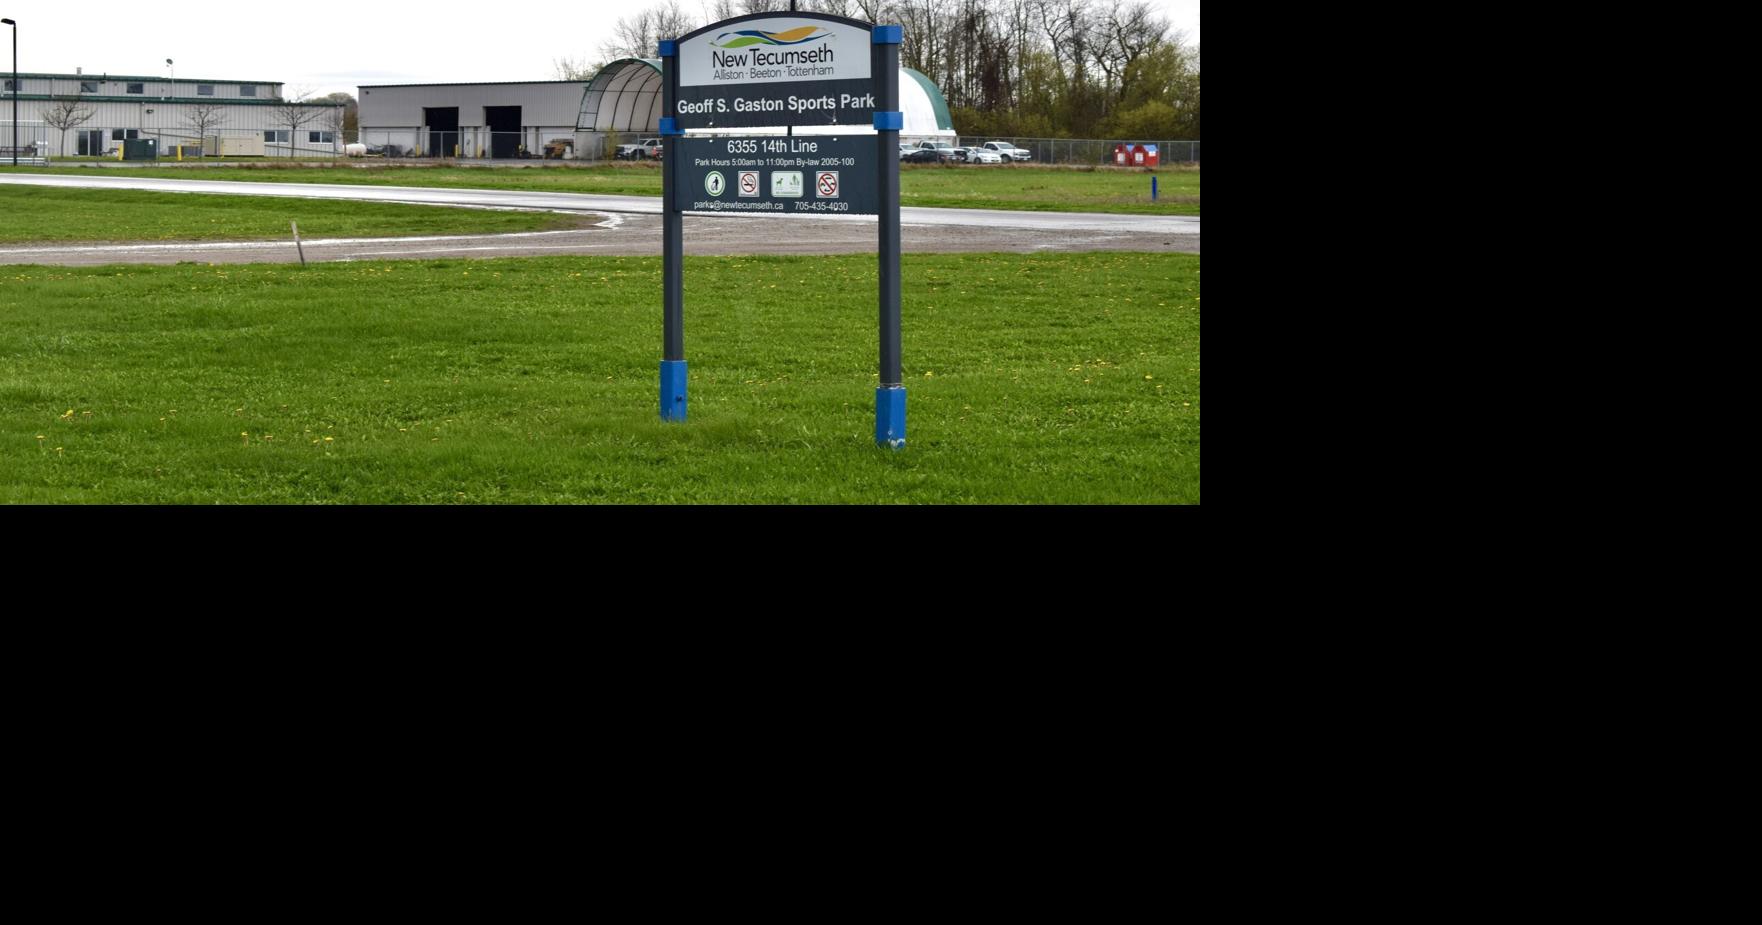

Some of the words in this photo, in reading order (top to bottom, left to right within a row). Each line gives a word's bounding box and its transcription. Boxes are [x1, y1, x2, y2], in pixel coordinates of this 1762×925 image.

[712, 50, 748, 68] New
[749, 43, 834, 66] Tecumseth
[713, 69, 744, 81] Alliston
[750, 68, 782, 79] Beeton
[786, 64, 834, 77] Tottenham
[677, 99, 714, 114] Geoff
[716, 99, 730, 113] S.
[734, 97, 784, 112] Gaston
[788, 95, 836, 113] Sports
[840, 93, 875, 109] Park
[727, 140, 758, 153] 6355
[761, 139, 787, 153] 14th
[791, 139, 818, 153] Line
[695, 158, 710, 166] Park
[711, 158, 730, 166] Hours
[731, 158, 757, 167] 5:00am
[766, 158, 794, 168] 11:00pm
[796, 157, 820, 168] By-law
[821, 157, 855, 166] 2005-100
[694, 200, 784, 211] parks@newtecumseth.ca
[794, 201, 849, 211] 705-435-4030
